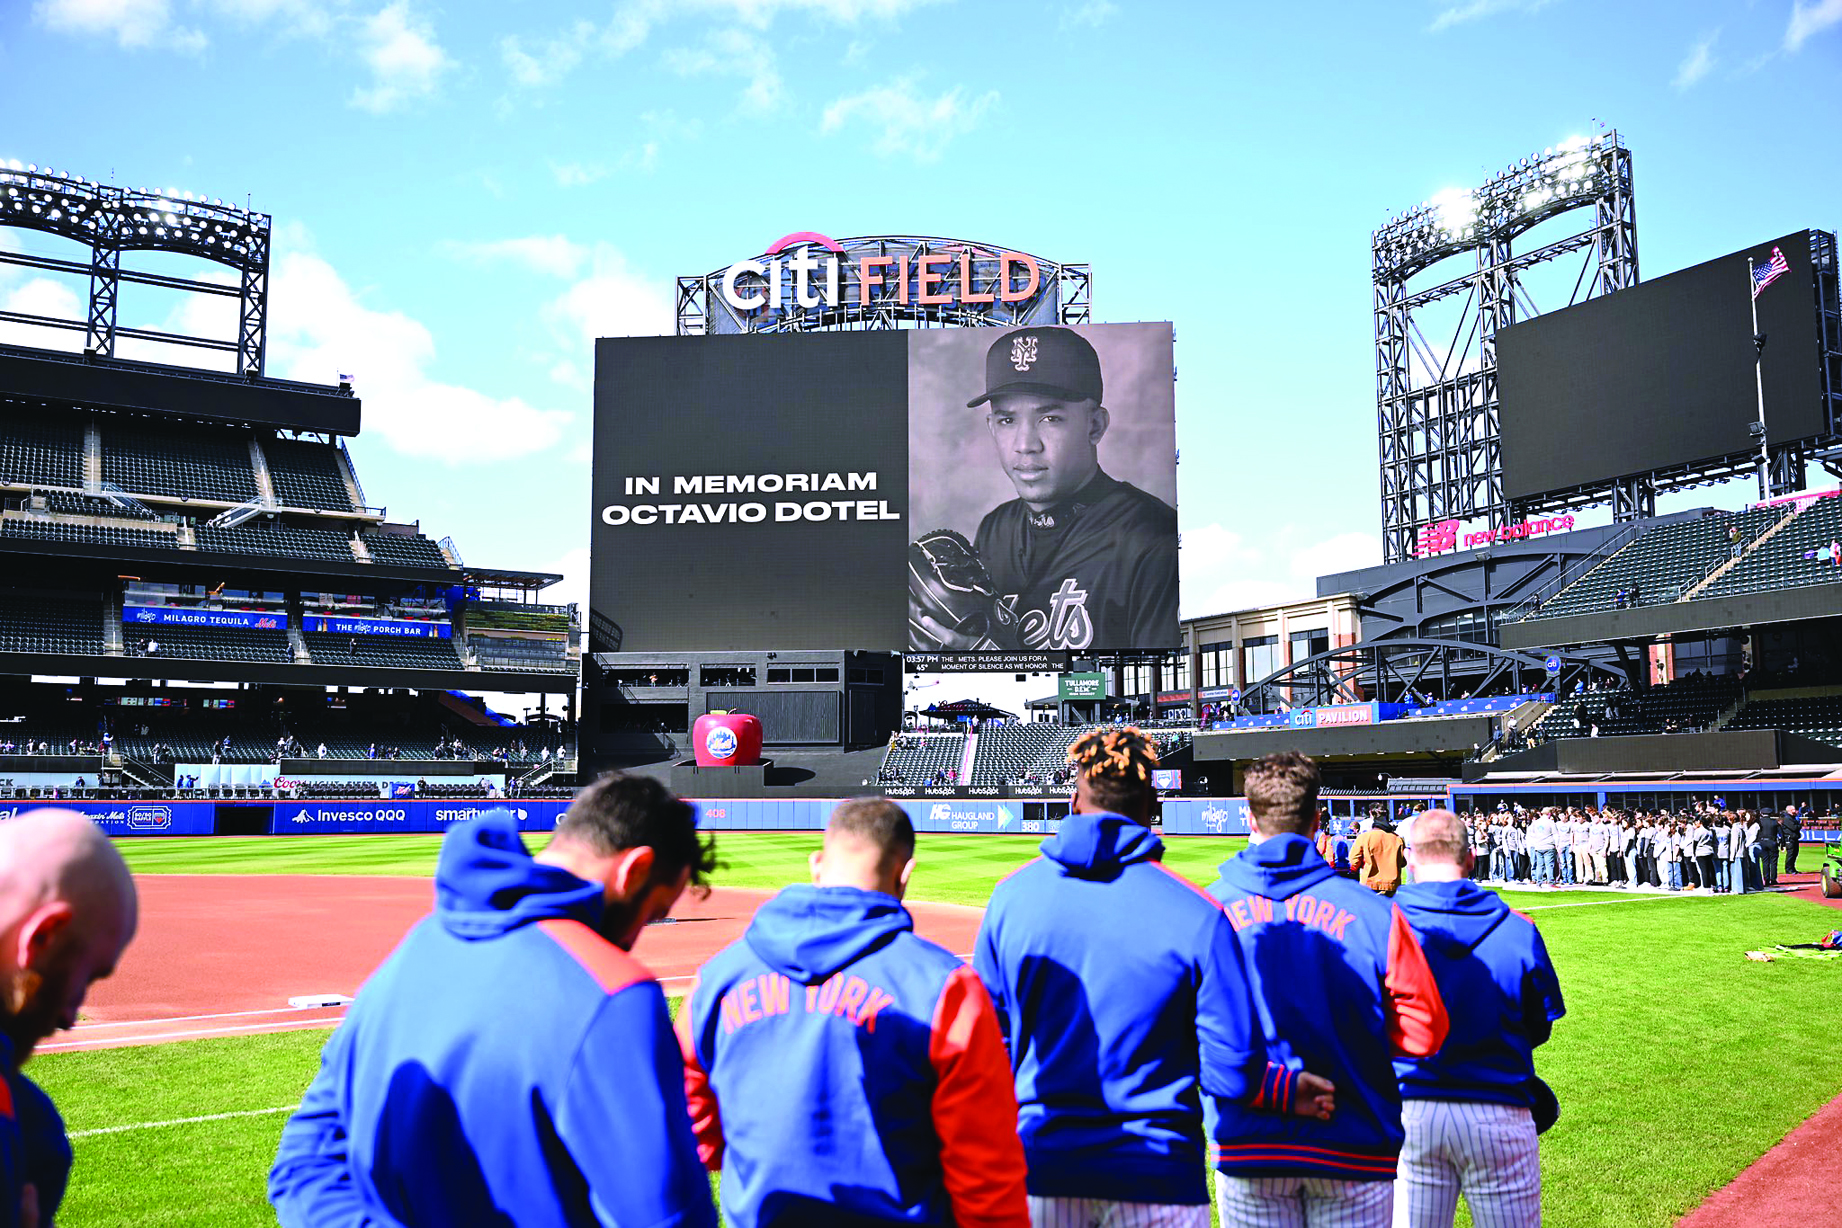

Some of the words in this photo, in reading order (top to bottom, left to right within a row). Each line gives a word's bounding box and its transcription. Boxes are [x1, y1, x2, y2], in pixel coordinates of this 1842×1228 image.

[723, 246, 839, 310] citi
[861, 252, 1041, 306] FIELD
[625, 476, 660, 495] IN
[674, 472, 877, 494] MEMORIAM
[601, 502, 767, 525] OCTAVIO
[775, 500, 900, 522] DOTEL
[1463, 528, 1496, 548] new
[1500, 514, 1575, 540] balance
[163, 613, 207, 623] MILAGRO
[209, 616, 249, 626] TEQUILA
[336, 623, 353, 631] THE
[373, 626, 401, 634] PORCH
[404, 627, 421, 635] BAR
[1295, 712, 1312, 726] citi
[1318, 709, 1368, 725] PAVILION
[885, 787, 916, 796] HubSpot
[924, 787, 956, 796] HubSpot
[968, 787, 999, 796] HubSpot
[1014, 786, 1043, 795] HubSpot
[318, 809, 373, 822] Invesco
[376, 809, 406, 822] QQQ
[705, 808, 726, 819] 408
[951, 812, 995, 821] HAUGLAND
[951, 821, 979, 830] GROUP
[1022, 822, 1040, 832] 380
[1285, 893, 1357, 941] YORK
[721, 972, 790, 1035] NEW
[805, 971, 895, 1035] YORK
